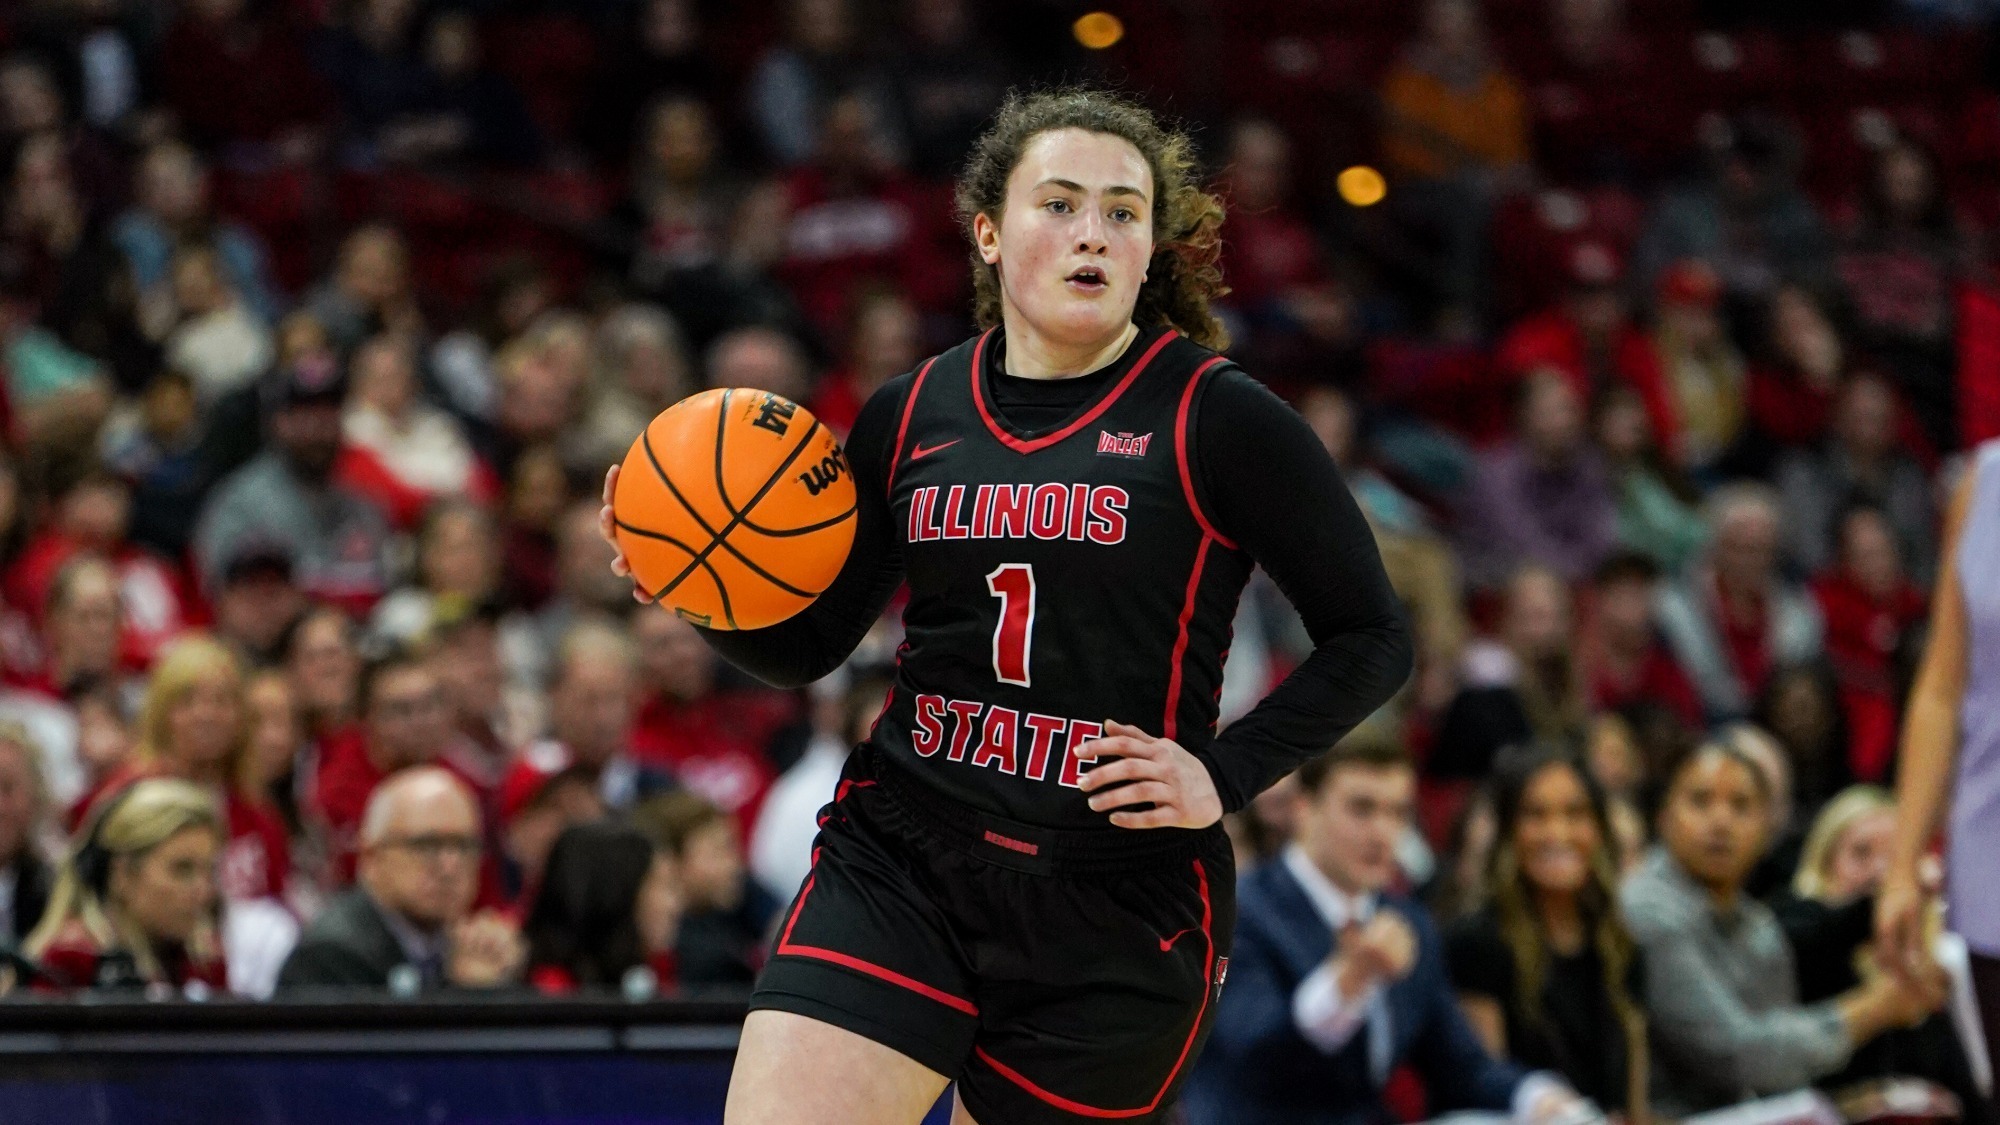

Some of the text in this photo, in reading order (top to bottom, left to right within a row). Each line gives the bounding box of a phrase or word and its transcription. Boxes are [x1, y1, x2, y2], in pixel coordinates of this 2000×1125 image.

[1097, 430, 1153, 456] VALLEY
[908, 483, 1129, 545] ILLINOIS
[985, 562, 1037, 689] 1
[911, 694, 1104, 788] STATE
[984, 830, 1038, 856] REDBIRDS
